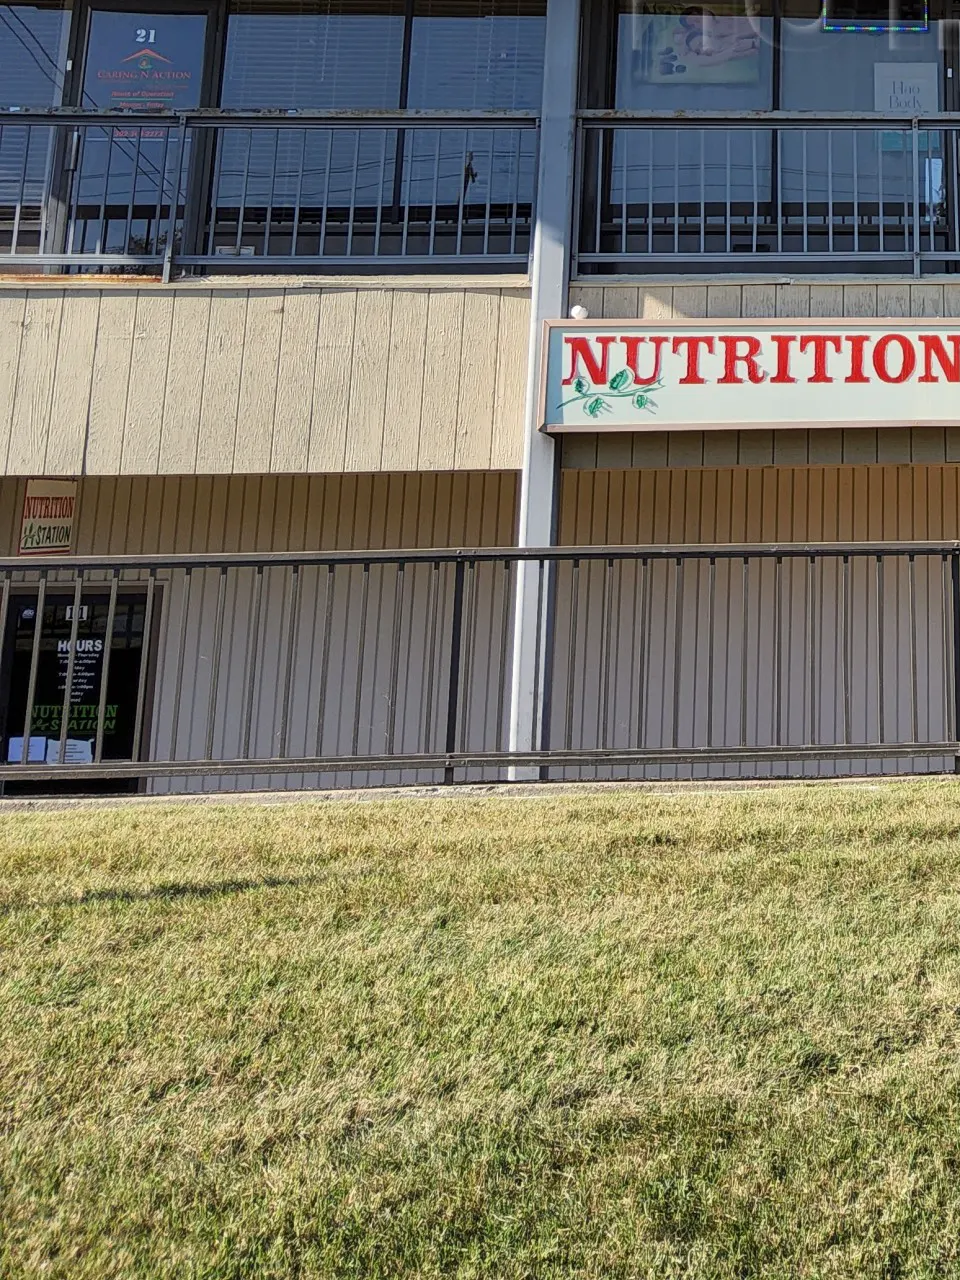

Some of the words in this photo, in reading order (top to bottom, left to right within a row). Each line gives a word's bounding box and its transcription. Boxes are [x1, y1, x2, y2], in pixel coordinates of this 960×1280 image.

[135, 28, 156, 43] 21
[24, 496, 75, 519] NUTRITION
[36, 524, 72, 545] STATION
